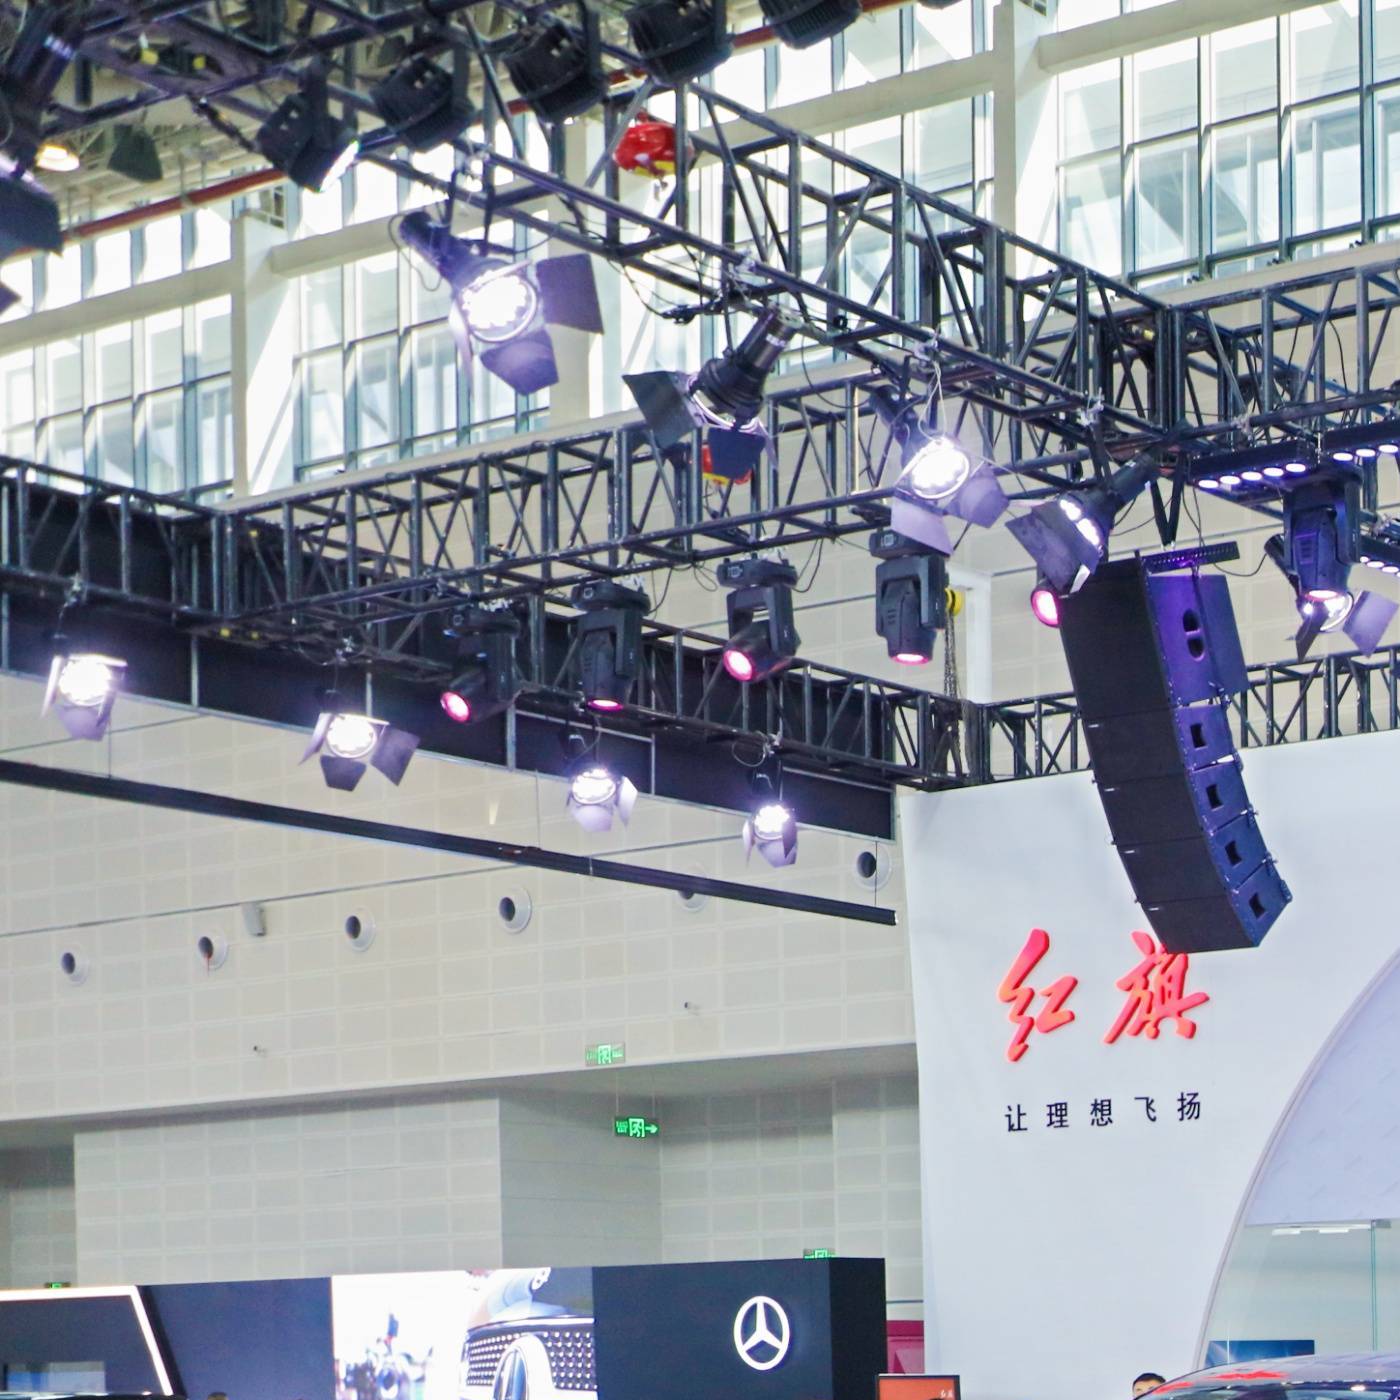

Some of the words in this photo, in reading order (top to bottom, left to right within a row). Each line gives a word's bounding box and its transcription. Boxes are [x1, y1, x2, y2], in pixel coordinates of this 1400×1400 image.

[998, 927, 1211, 1063] 红旗
[1004, 1091, 1202, 1134] 让理想飞扬
